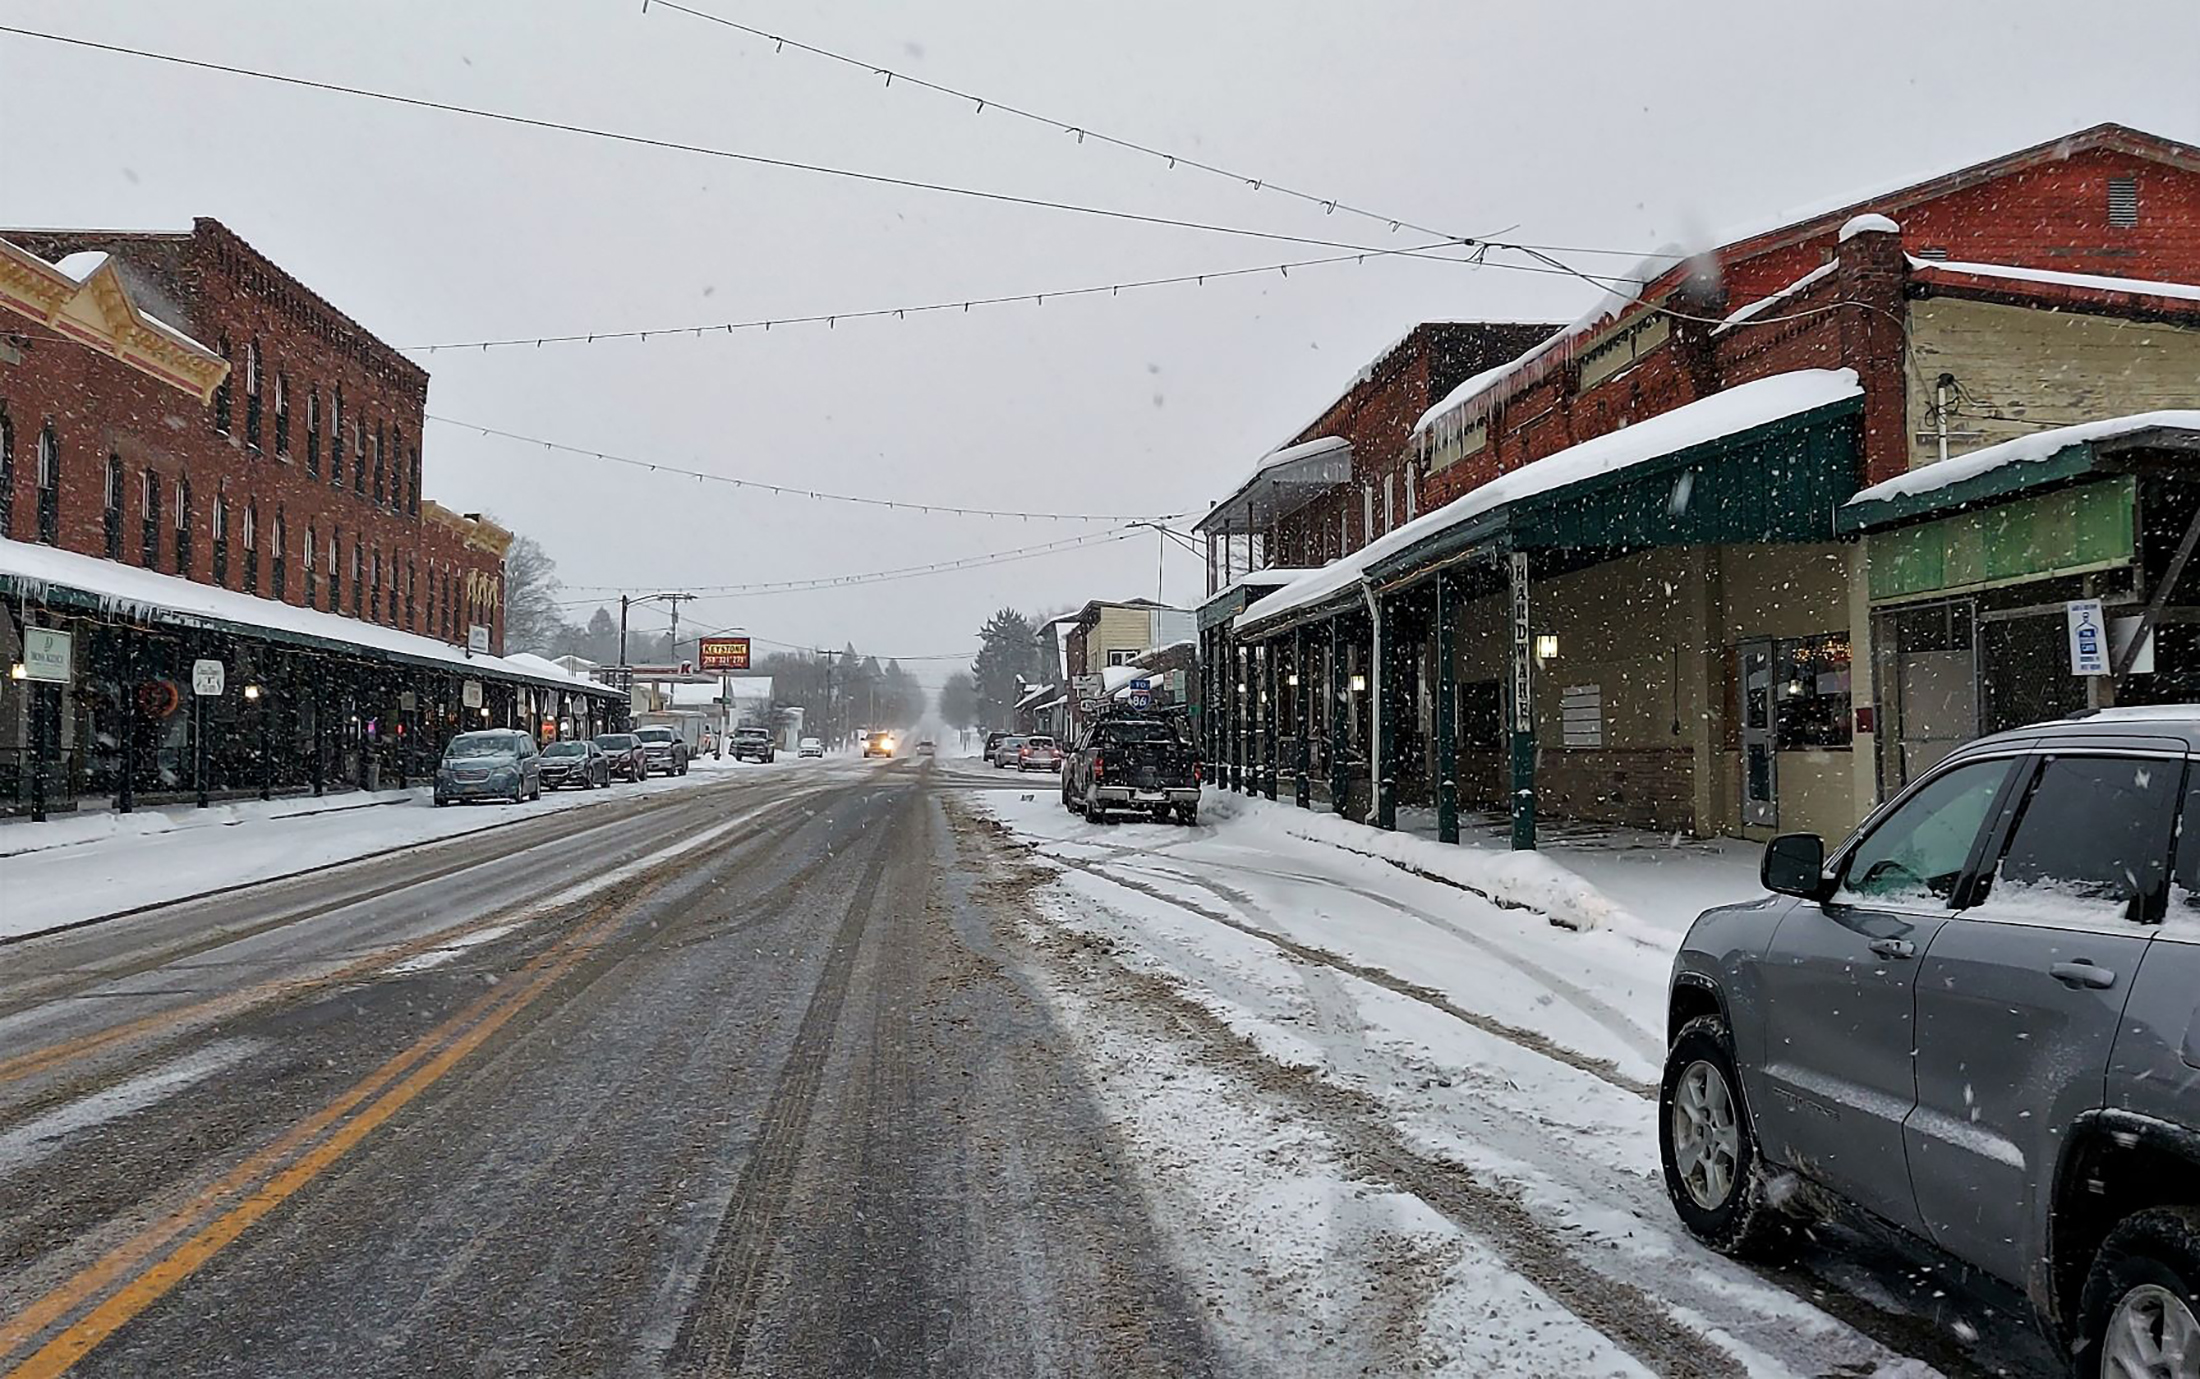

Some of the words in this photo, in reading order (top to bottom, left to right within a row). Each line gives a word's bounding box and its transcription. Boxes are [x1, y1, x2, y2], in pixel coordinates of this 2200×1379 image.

[1515, 564, 1529, 718] HARDWARE
[704, 644, 746, 654] KEYSTONE
[1136, 681, 1147, 689] TO
[1132, 695, 1147, 706] 86
